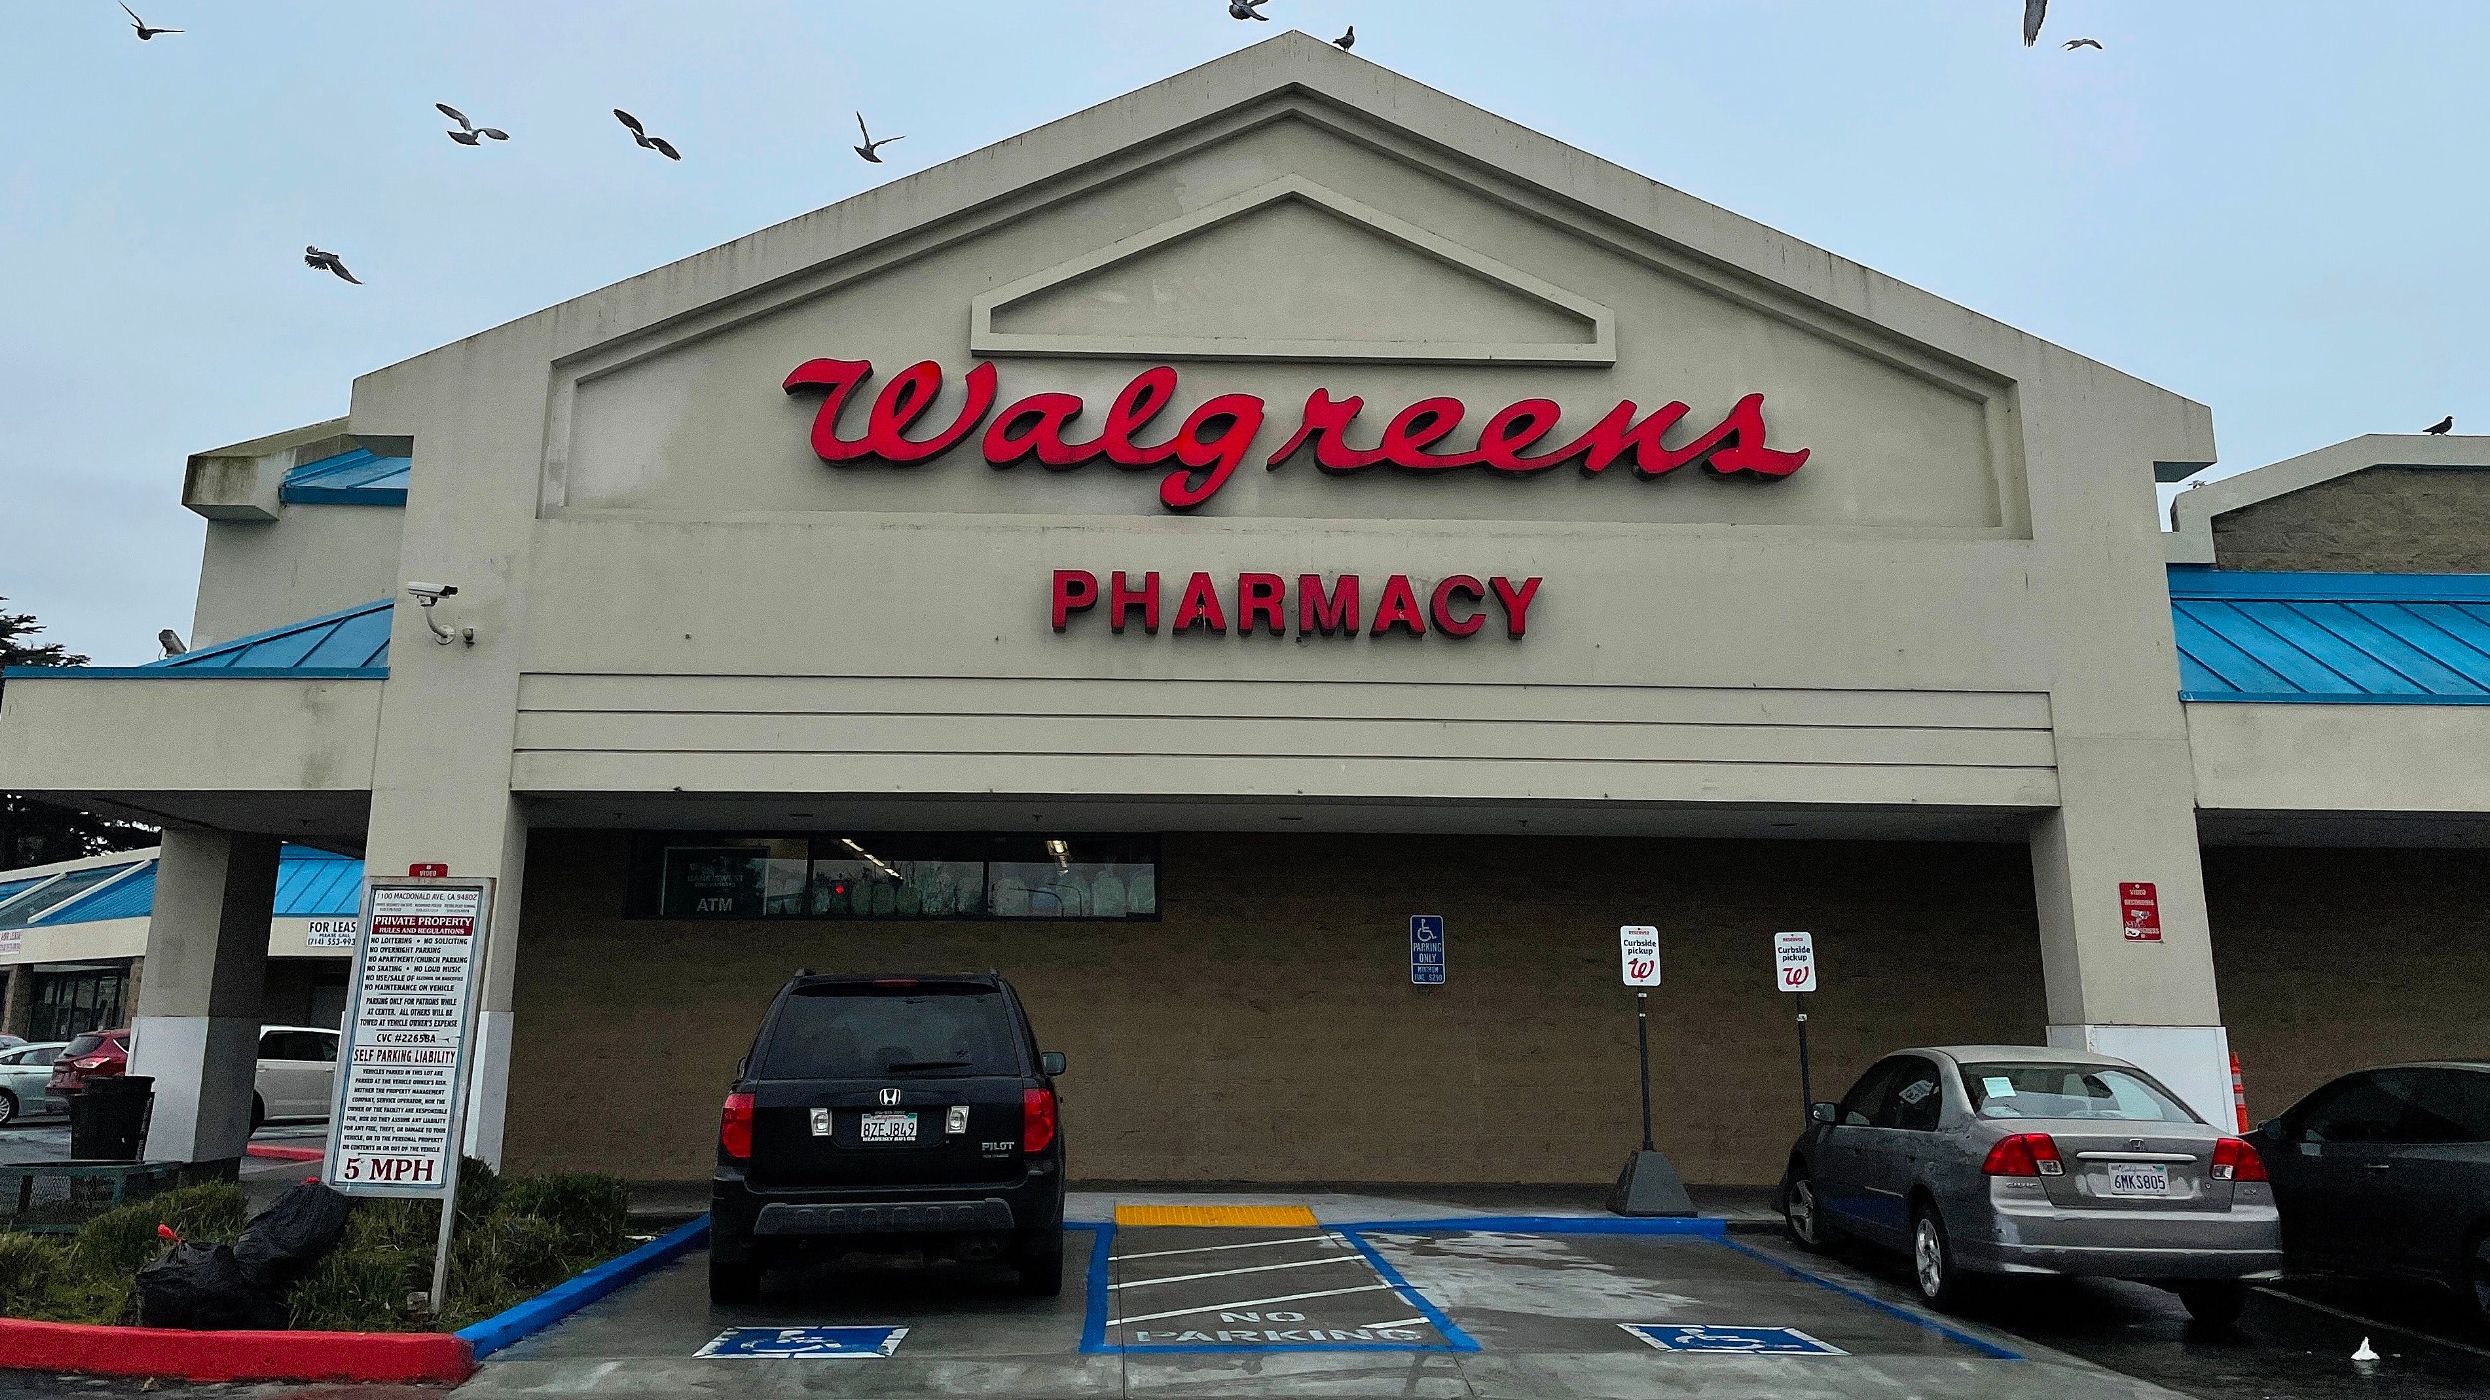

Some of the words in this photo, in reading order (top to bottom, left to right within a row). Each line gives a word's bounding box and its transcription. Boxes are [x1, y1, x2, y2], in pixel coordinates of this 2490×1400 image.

[782, 357, 1811, 512] Walgreens
[1052, 569, 1543, 641] PHARMACY
[696, 898, 732, 911] ATM
[375, 916, 416, 925] PRIVATE
[418, 917, 472, 926] PROPERTY
[309, 922, 329, 932] FOR
[333, 922, 356, 932] LEAS
[1414, 943, 1441, 952] PARKING
[1628, 947, 1653, 956] pickup
[1419, 953, 1436, 962] ONLY
[1783, 954, 1807, 962] pickup
[377, 1034, 392, 1042] CVC
[354, 1049, 374, 1061] SELF
[377, 1050, 412, 1062] PARKING
[415, 1051, 456, 1063] LIABILITY
[863, 1122, 914, 1137] 8ZEJ849
[982, 1142, 1014, 1150] PILOT
[345, 1158, 360, 1179] 5
[369, 1159, 434, 1181] MPH
[2115, 1175, 2165, 1189] 6MKS805
[1220, 1312, 1306, 1322] NO
[1136, 1330, 1422, 1342] PARKING
